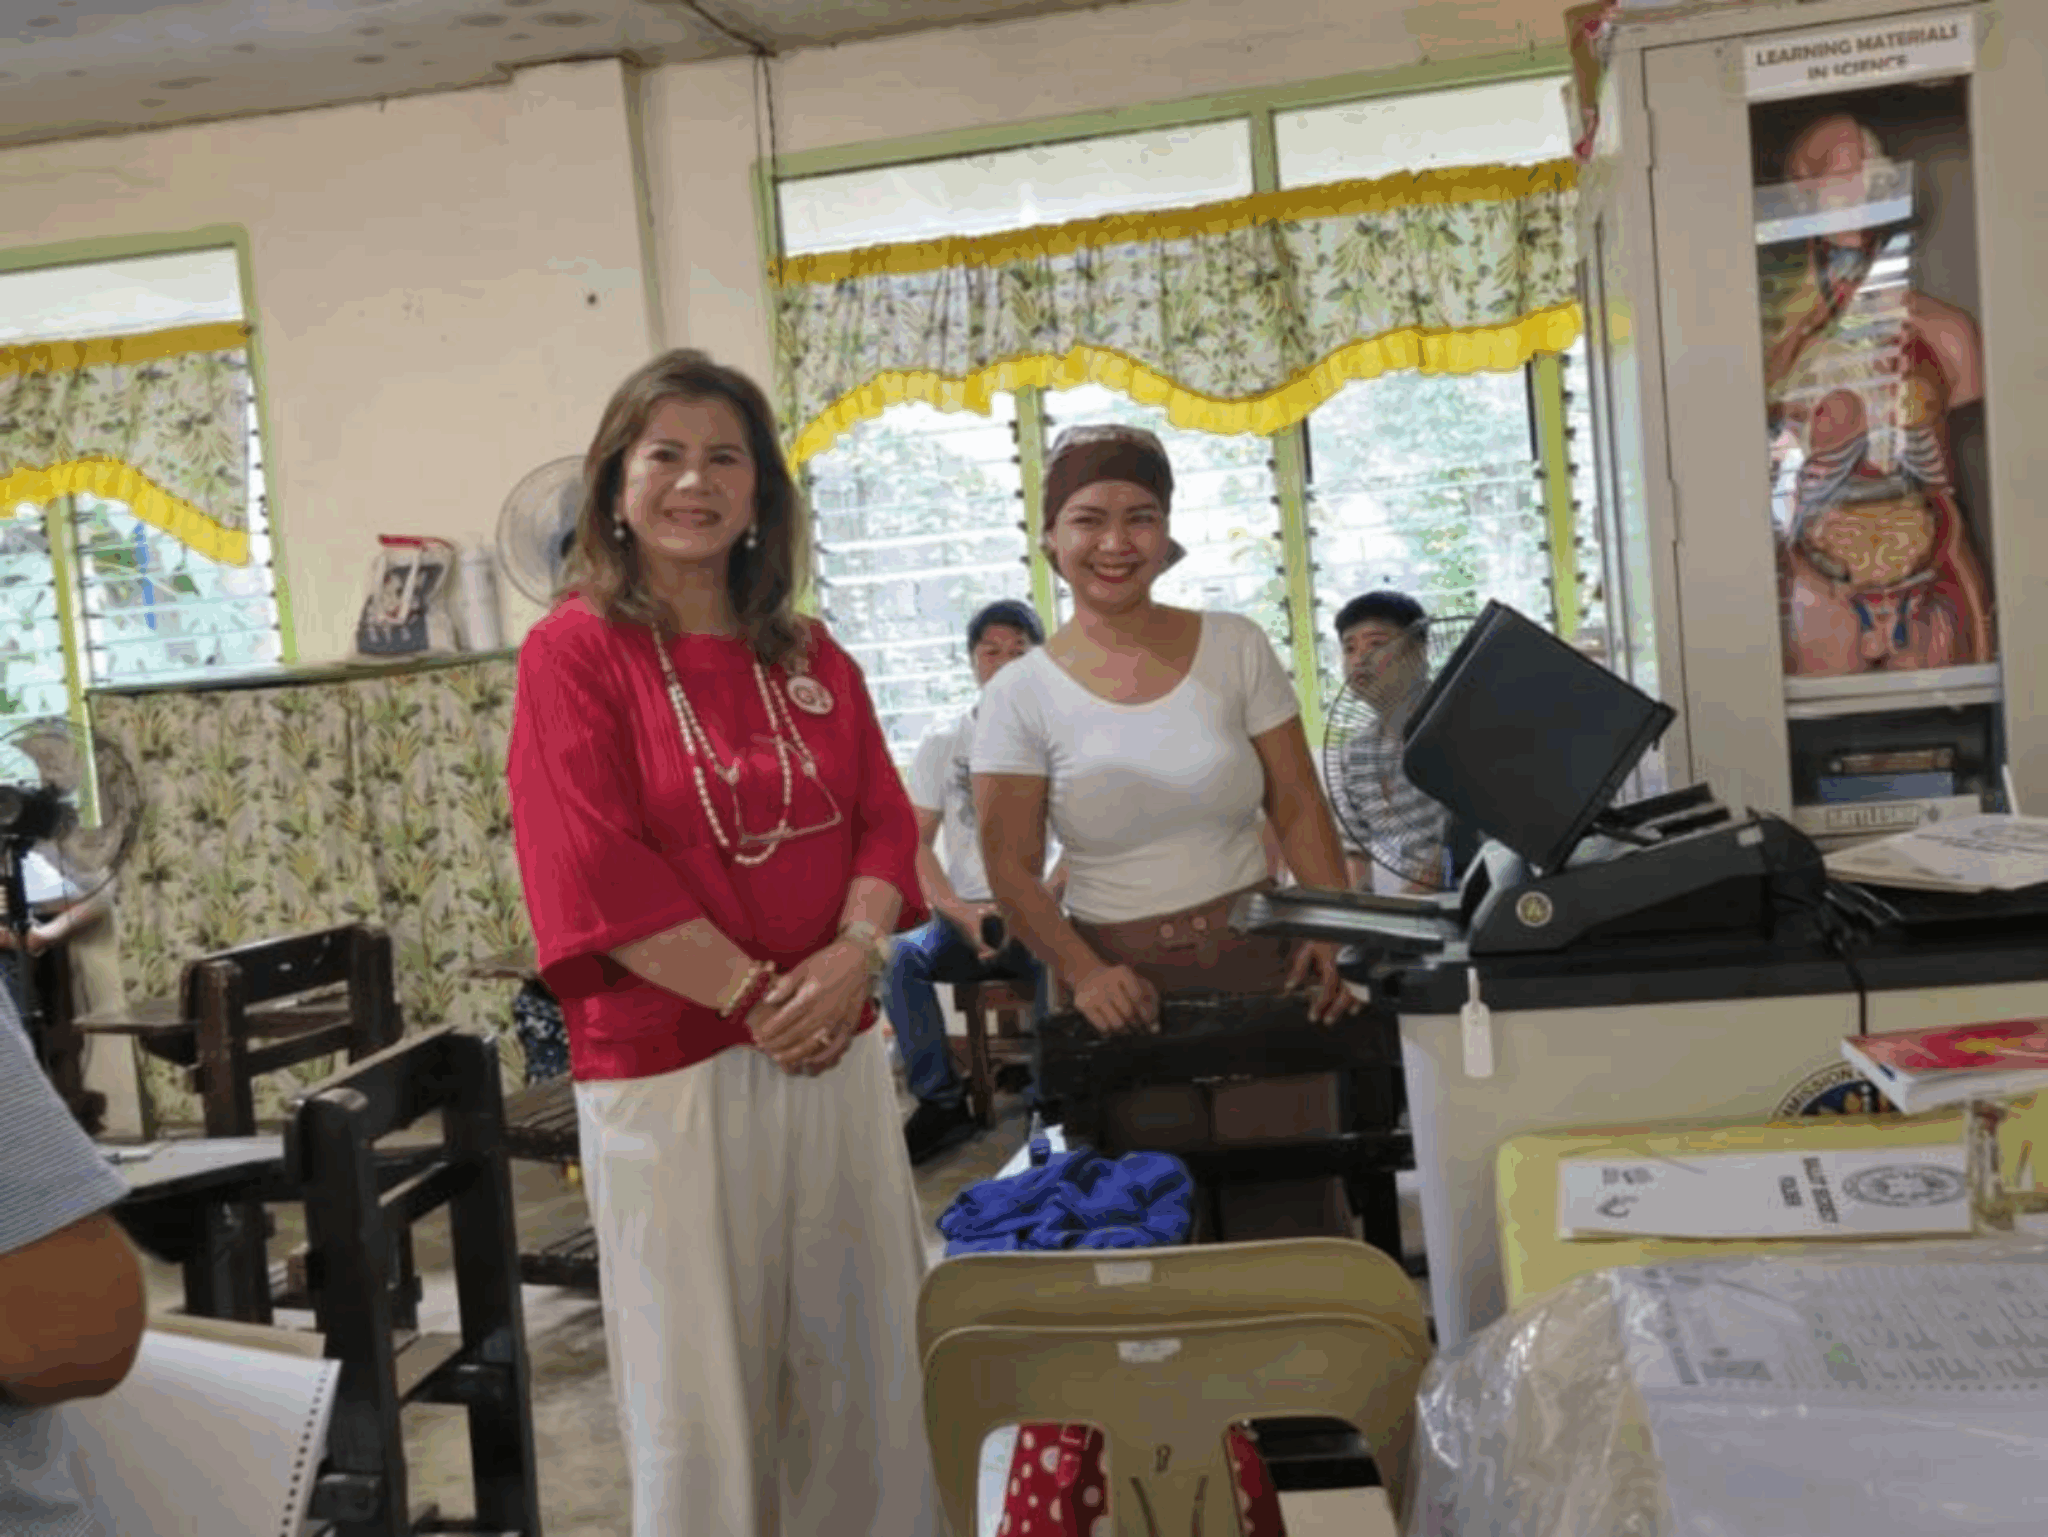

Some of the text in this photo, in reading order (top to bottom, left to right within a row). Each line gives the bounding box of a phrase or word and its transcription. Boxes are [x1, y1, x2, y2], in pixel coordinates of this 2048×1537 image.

[1756, 25, 1958, 67] LEARNING MATERIALS
[1808, 55, 1907, 80] IN SCIENCE
